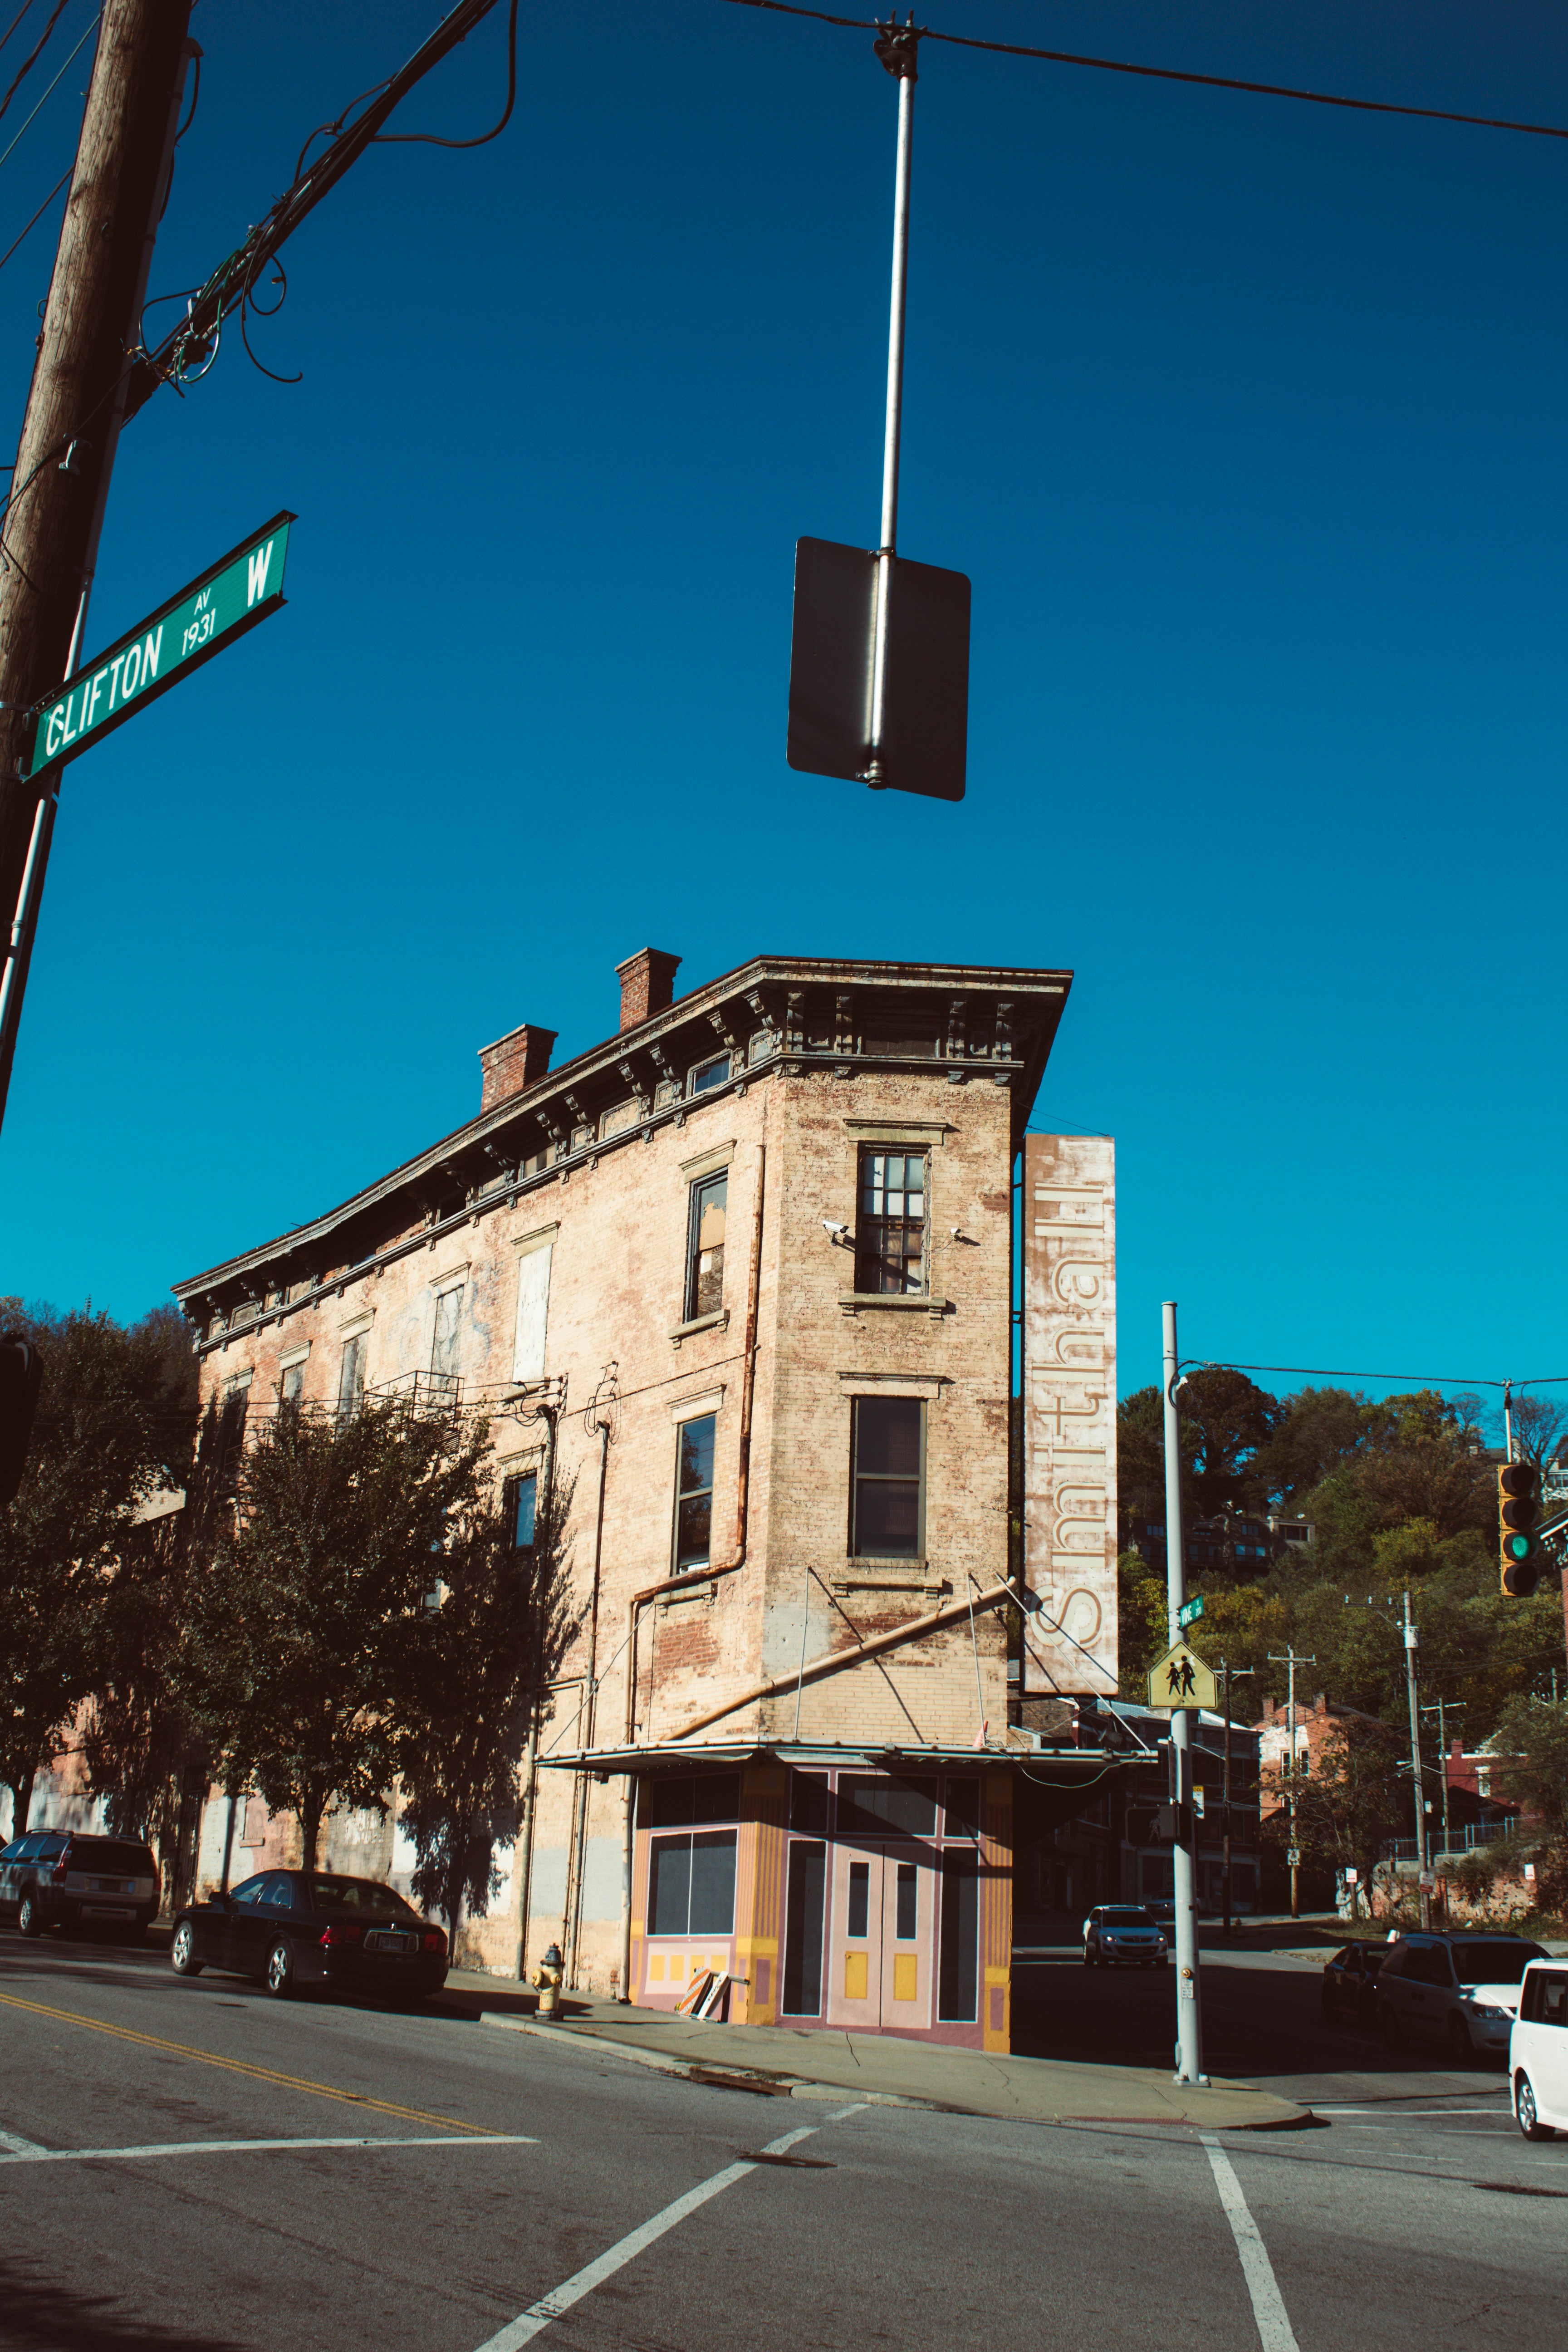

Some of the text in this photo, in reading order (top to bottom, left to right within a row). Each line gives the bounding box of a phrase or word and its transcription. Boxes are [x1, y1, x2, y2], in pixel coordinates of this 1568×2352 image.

[194, 588, 211, 615] AV
[247, 540, 273, 607] W
[182, 608, 216, 656] 1931
[46, 624, 163, 756] CLIFTON
[1029, 1182, 1106, 1649] Smithall
[1181, 1605, 1192, 1625] VINE
